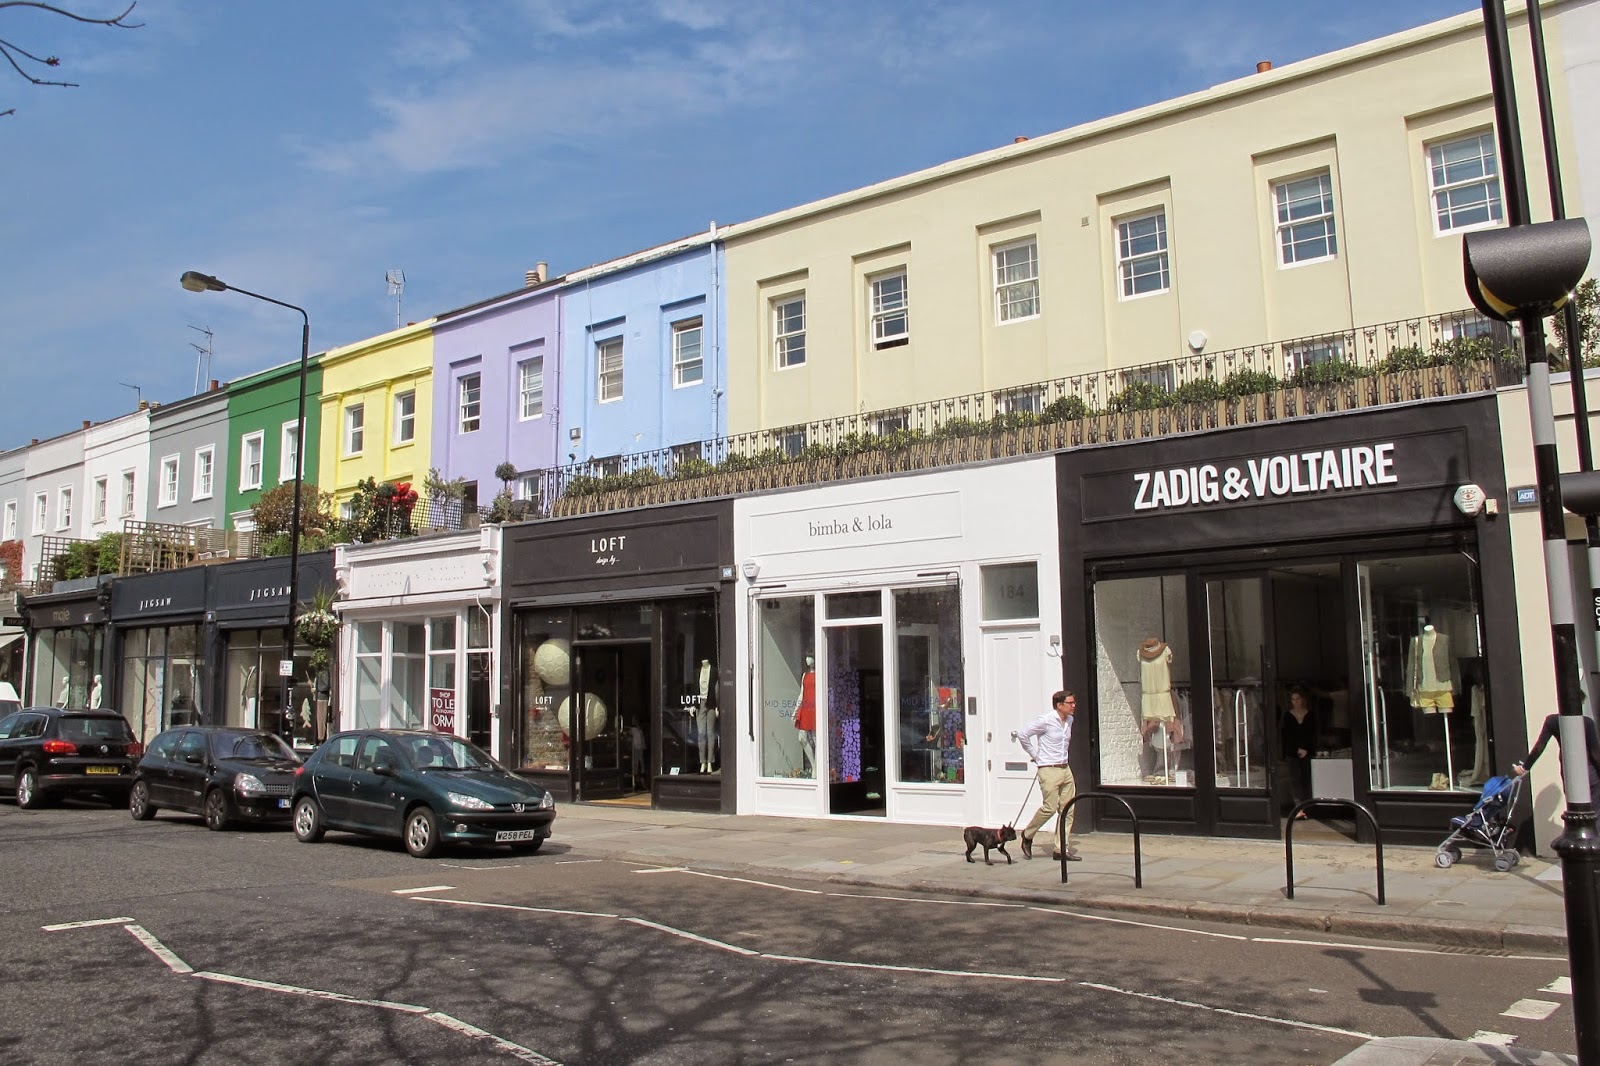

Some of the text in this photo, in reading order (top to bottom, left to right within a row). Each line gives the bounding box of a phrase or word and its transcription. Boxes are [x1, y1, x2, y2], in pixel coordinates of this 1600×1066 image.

[809, 514, 893, 537] bimba & lola
[591, 536, 626, 553] LOFT
[250, 586, 292, 601] JIGSAW
[999, 585, 1025, 600] 184
[139, 597, 172, 611] JIGSAW
[432, 697, 454, 710] TO LE
[535, 696, 553, 705] LOFT
[680, 695, 701, 705] LOFT
[764, 700, 779, 708] MID
[433, 714, 454, 728] ORM
[519, 830, 533, 839] PEL
